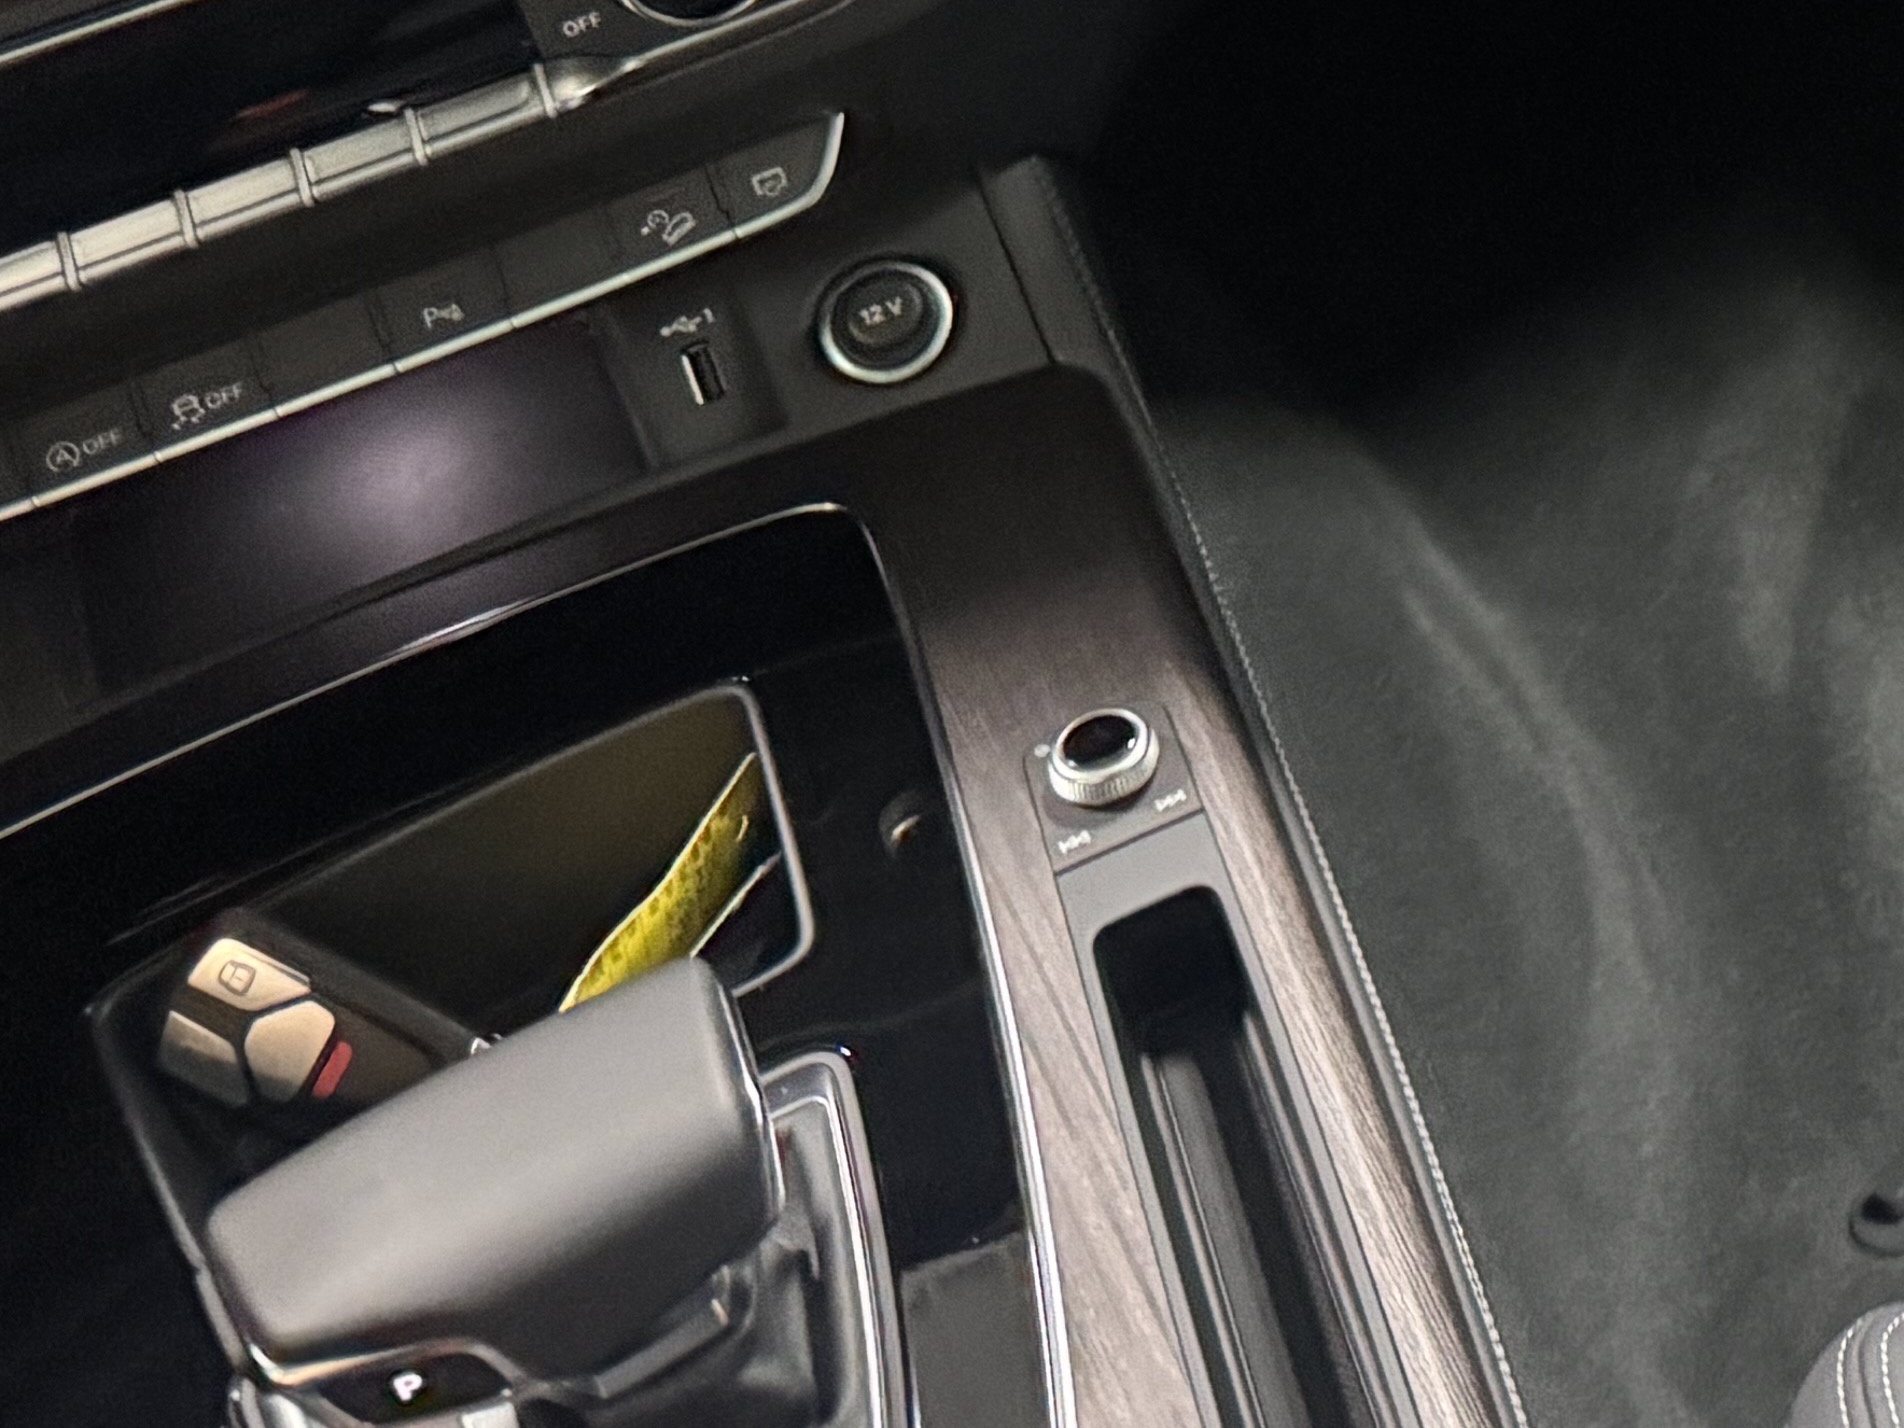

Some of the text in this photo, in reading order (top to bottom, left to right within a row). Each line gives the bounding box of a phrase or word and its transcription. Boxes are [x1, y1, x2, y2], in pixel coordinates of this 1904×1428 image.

[563, 11, 601, 38] OFF
[859, 296, 903, 326] 12 V
[204, 381, 243, 409] OFF
[82, 428, 121, 455] OFF
[393, 1372, 423, 1401] P
